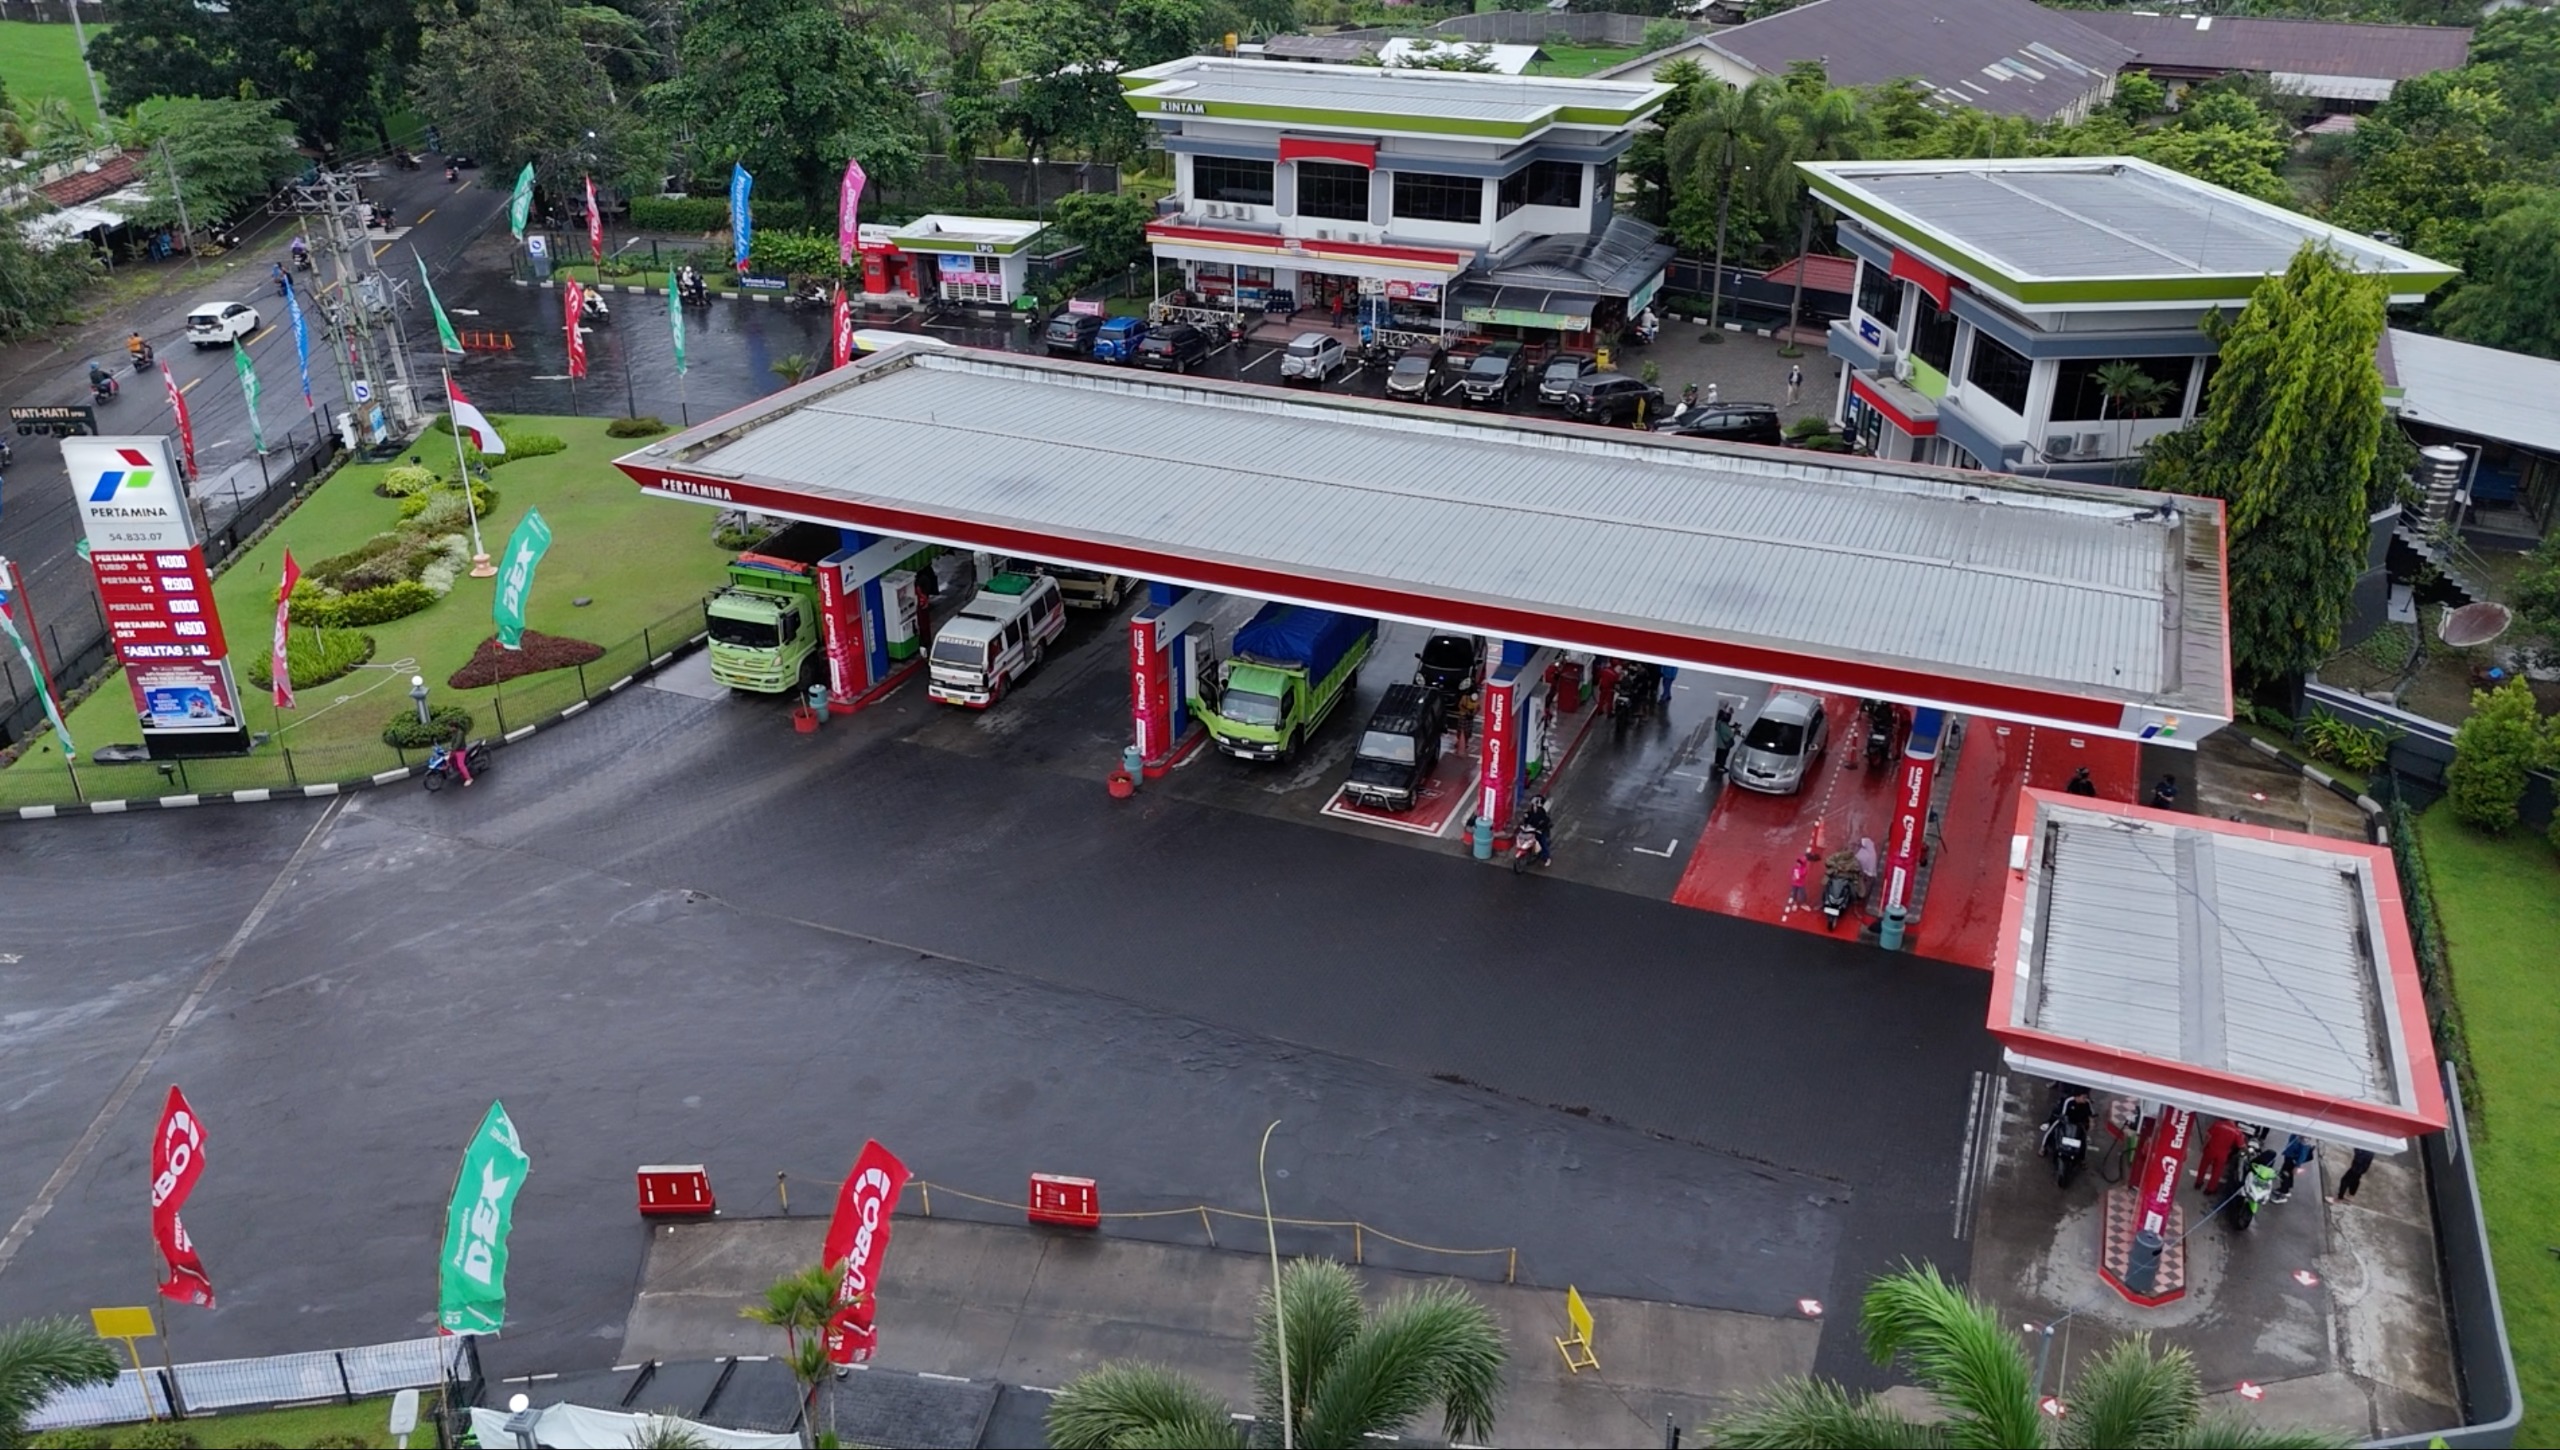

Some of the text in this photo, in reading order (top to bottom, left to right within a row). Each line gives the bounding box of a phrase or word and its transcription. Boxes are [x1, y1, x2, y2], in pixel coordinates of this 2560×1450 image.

[1160, 101, 1205, 114] RINTAM
[975, 244, 994, 253] LPG
[11, 408, 69, 418] HATI-HATI
[661, 478, 733, 501] PERTAMINA
[90, 507, 168, 518] PERTAMINA
[109, 533, 163, 541] 54.833.07
[95, 553, 146, 562] PERTAMAX
[98, 563, 128, 571] TURBO
[101, 576, 152, 584] PERTAMAX
[507, 536, 535, 619] DEX
[823, 572, 833, 607] Enduro
[109, 603, 155, 611] PERTALITE
[113, 621, 168, 629] PERTAMINA
[1137, 629, 1146, 666] Enduro
[1493, 694, 1504, 732] Enduro
[1908, 767, 1923, 808] Enduro
[1900, 815, 1915, 858] TURBO
[2157, 1156, 2178, 1203] TURBO
[464, 1156, 510, 1286] DEX
